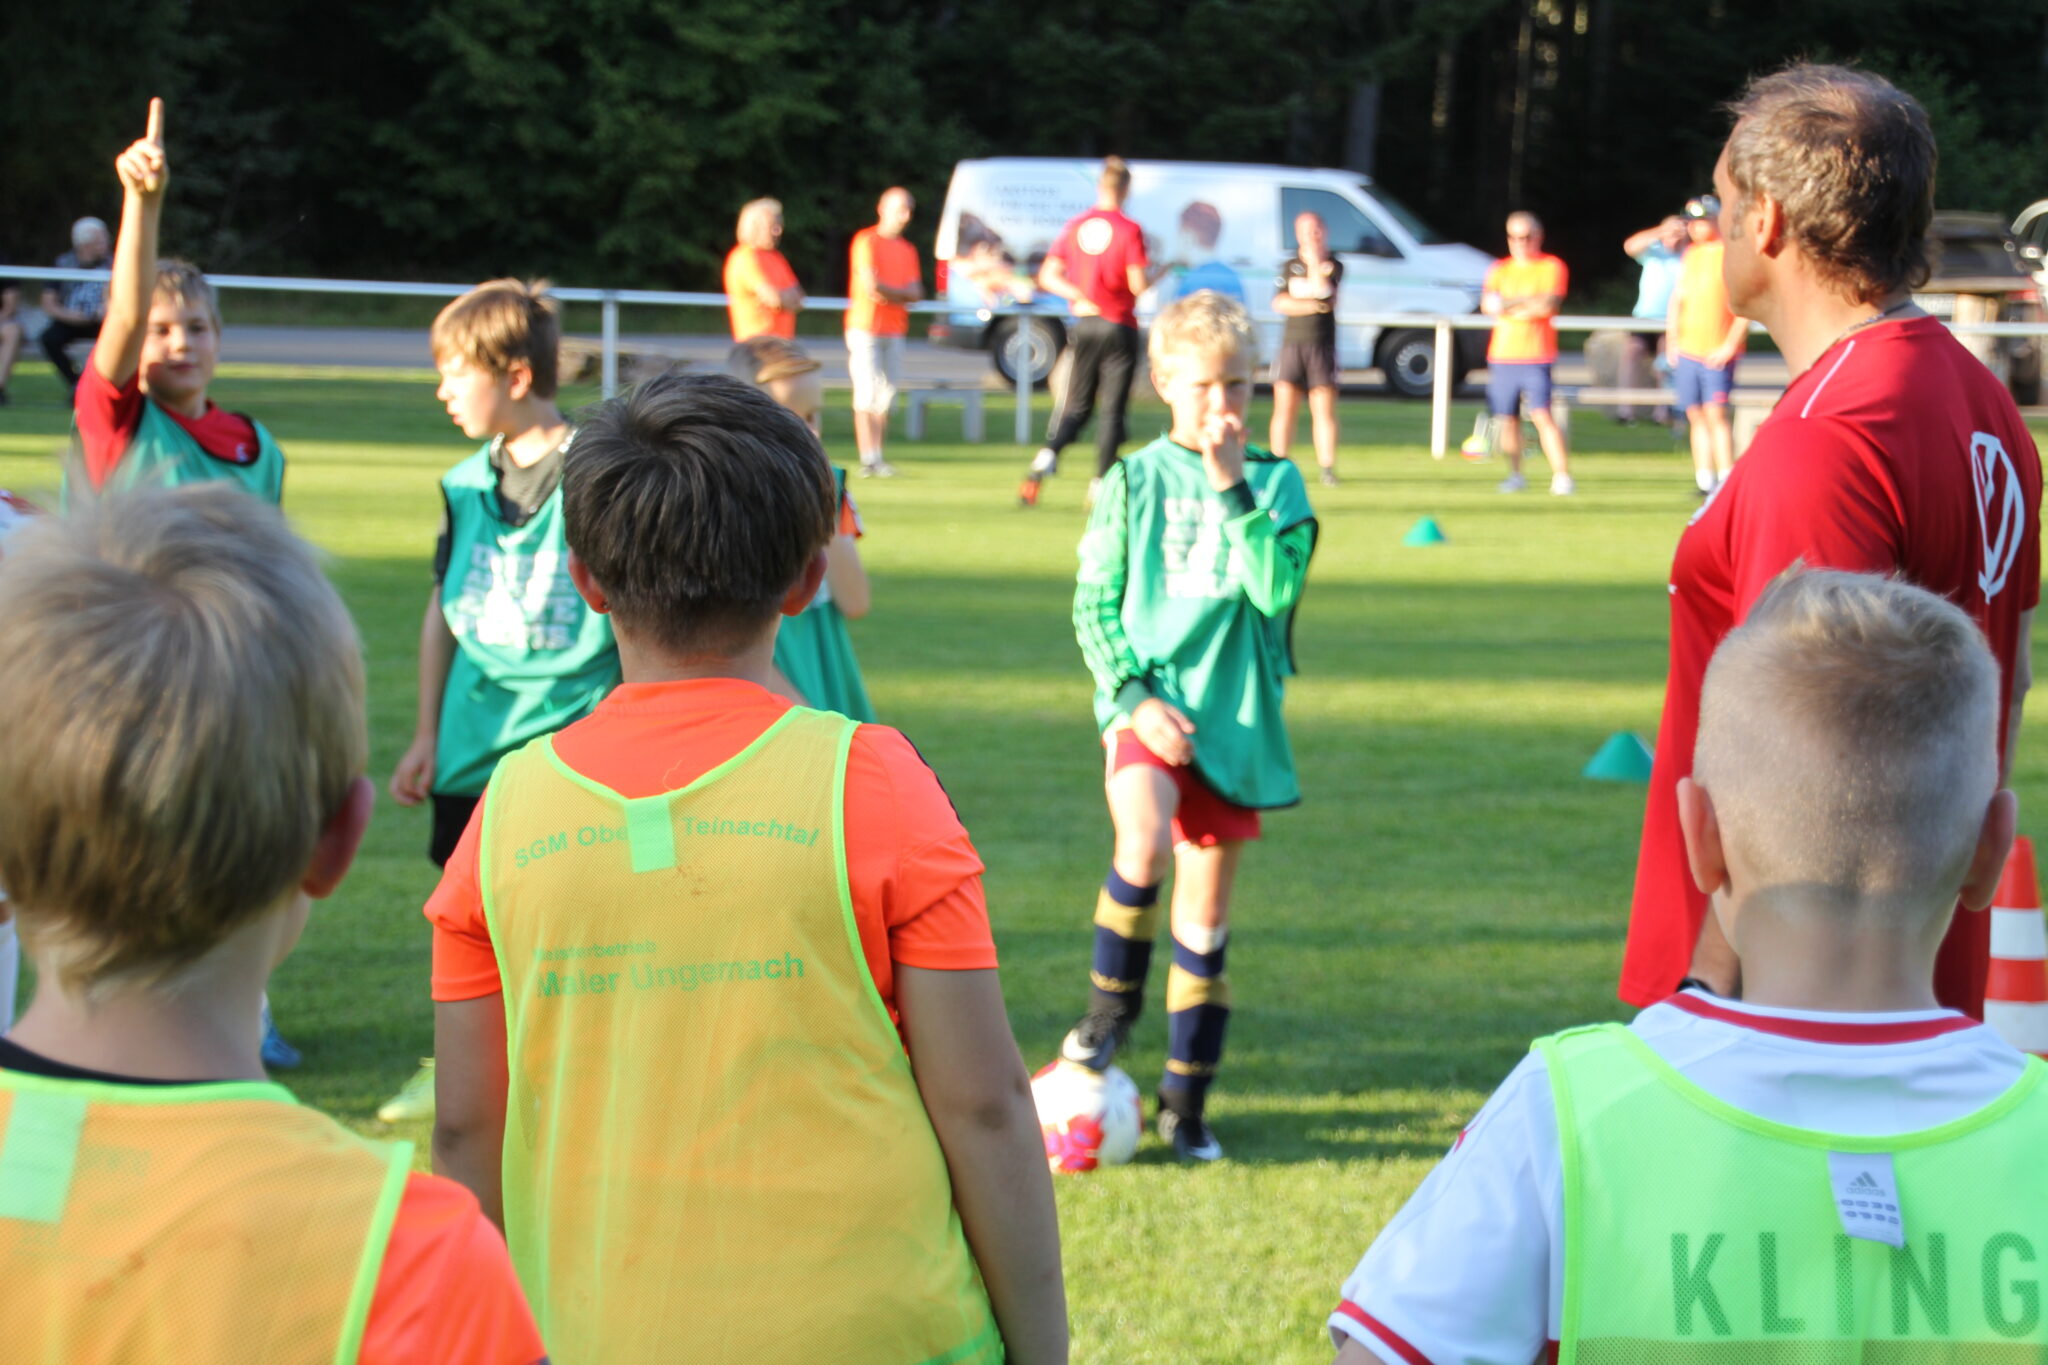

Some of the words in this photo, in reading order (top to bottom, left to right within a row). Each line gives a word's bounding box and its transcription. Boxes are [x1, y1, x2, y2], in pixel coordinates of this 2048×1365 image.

[515, 831, 568, 868] SGM
[577, 825, 629, 846] Obe
[682, 816, 820, 847] Teinachtal
[538, 968, 620, 997] Maler
[630, 951, 804, 992] Ungemach
[1671, 1232, 2040, 1338] KLING
